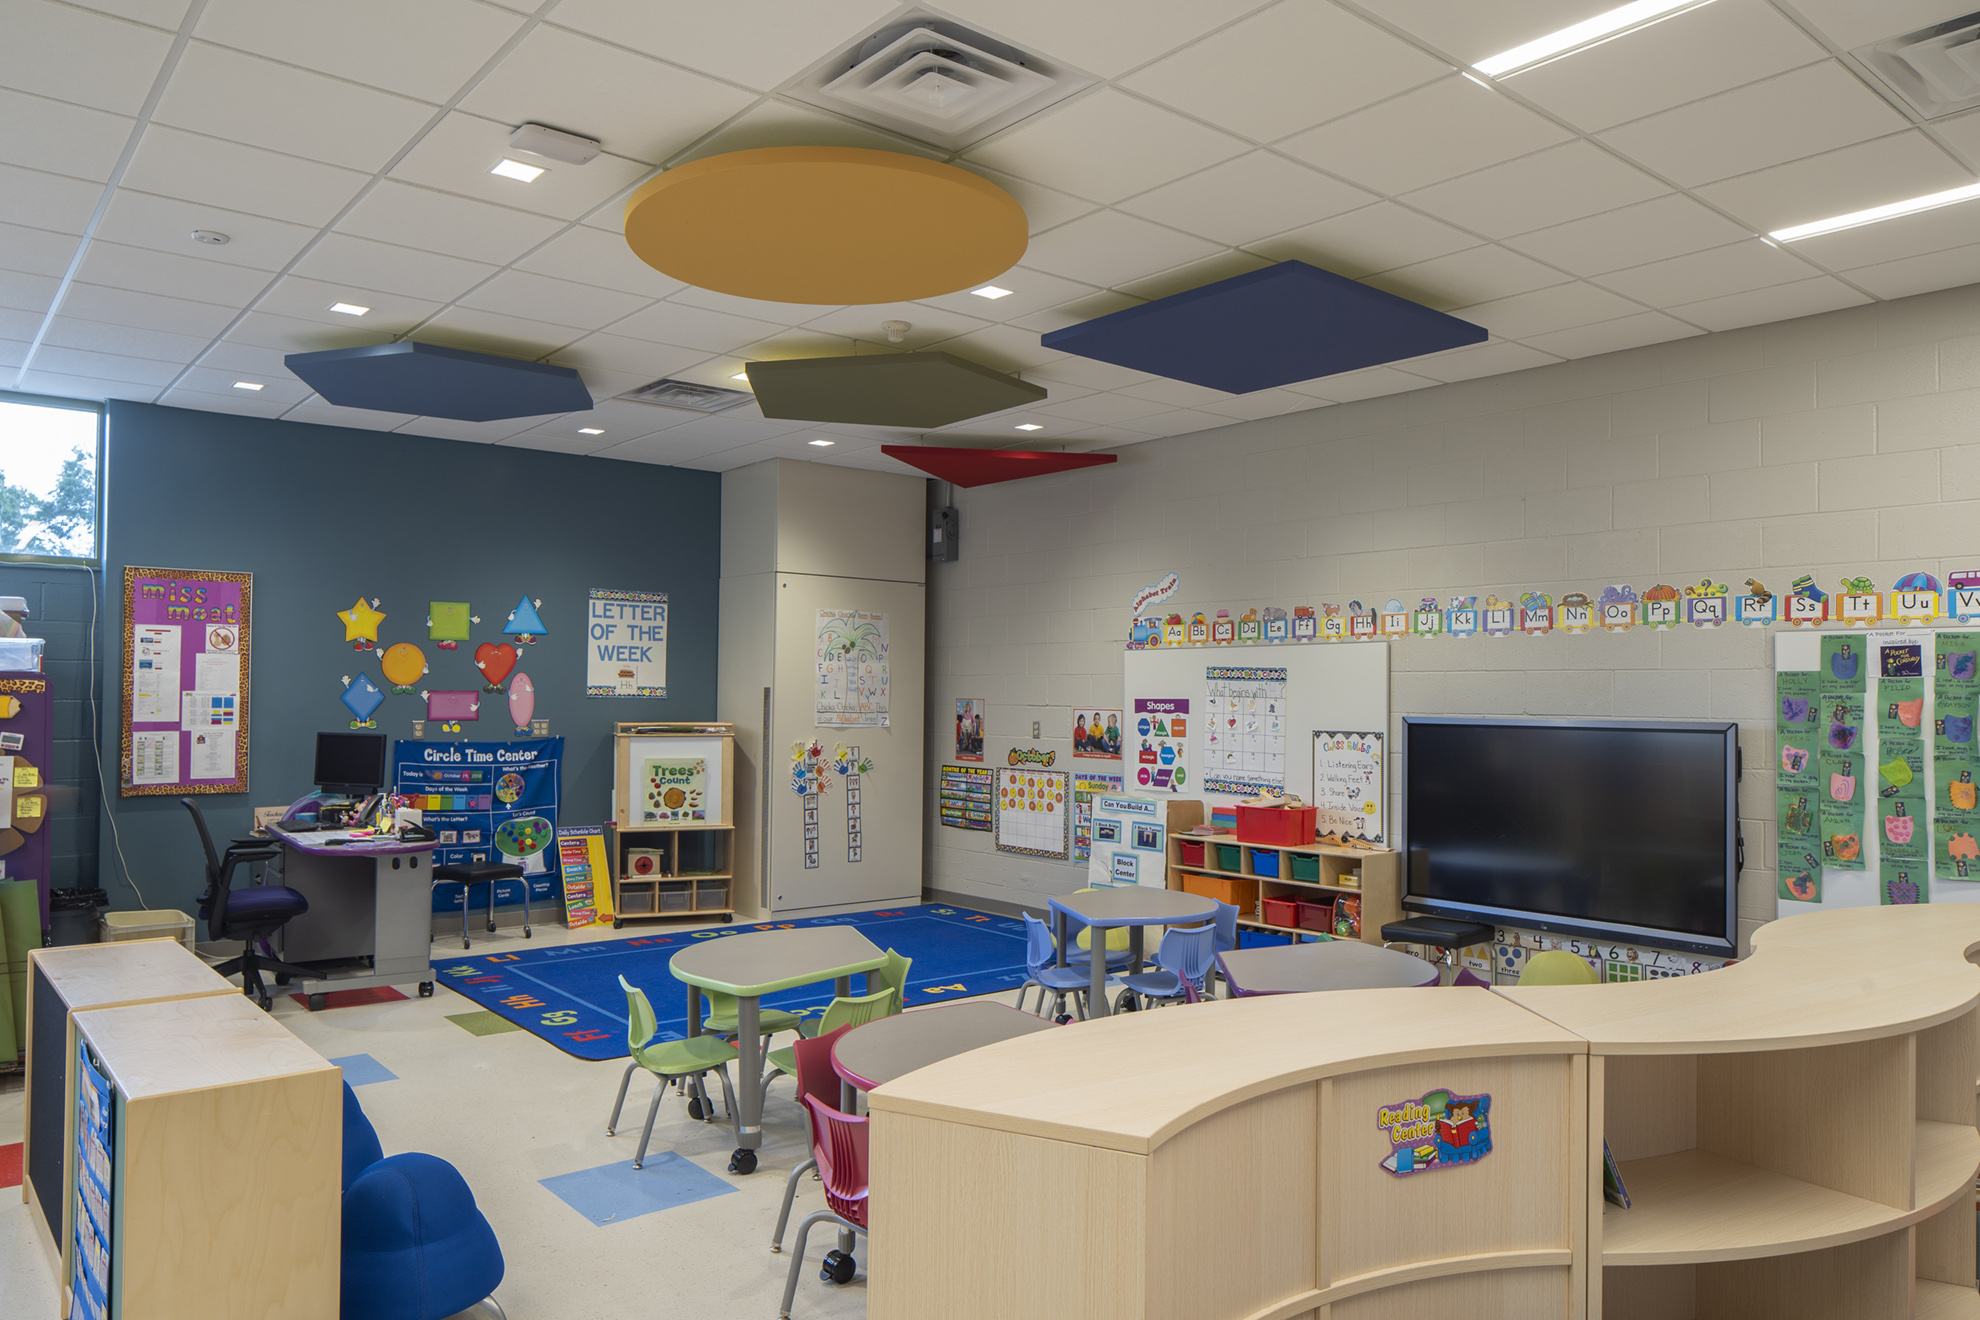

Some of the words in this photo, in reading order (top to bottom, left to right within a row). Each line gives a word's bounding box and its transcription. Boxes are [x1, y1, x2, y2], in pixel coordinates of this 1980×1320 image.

[142, 581, 207, 604] miss
[1134, 590, 1158, 612] Alphabet
[1160, 578, 1176, 594] Train
[1796, 598, 1816, 612] Ss
[1848, 596, 1870, 610] Tt
[1902, 594, 1928, 609] Uu
[167, 604, 236, 624] moat
[592, 602, 666, 622] LETTER
[1566, 608, 1586, 620] Nn
[1607, 605, 1628, 618] Oo
[1652, 602, 1670, 621] Pp
[1694, 600, 1718, 618] Qq
[1390, 615, 1400, 628] Ii
[1420, 614, 1434, 630] Jj
[1455, 613, 1472, 625] Kk
[1526, 610, 1548, 622] Mm
[1242, 622, 1256, 633] Dd
[1270, 622, 1282, 632] Ee
[1298, 619, 1310, 630] Ff
[1325, 619, 1340, 634] Gg
[1356, 617, 1372, 628] Hh
[590, 623, 618, 640] OF
[627, 624, 664, 642] THE
[1168, 626, 1182, 637] Aa
[1192, 626, 1204, 636] Bb
[1216, 624, 1230, 634] Cc
[597, 644, 653, 662] WEEK
[837, 652, 842, 662] E
[620, 680, 633, 689] Hh
[821, 674, 828, 684] I
[1206, 682, 1228, 697] What
[1146, 701, 1175, 712] Shapes
[881, 717, 889, 726] Z
[1323, 740, 1344, 752] CLASS
[1346, 741, 1372, 754] RULES
[424, 747, 461, 761] Circle
[465, 749, 493, 762] Time
[497, 749, 538, 761] Center
[1016, 750, 1050, 762] October
[652, 765, 694, 777] Trees
[1328, 760, 1357, 773] Listening
[1357, 760, 1374, 770] Ears
[660, 776, 691, 784] Count
[1326, 774, 1347, 786] Walking
[1348, 775, 1363, 783] Feet
[1088, 782, 1109, 791] Sunday
[1329, 788, 1345, 796] Share
[1127, 803, 1142, 811] Build
[1327, 801, 1346, 811] Inside
[1329, 816, 1338, 824] Be
[1339, 816, 1353, 826] Nice
[1117, 859, 1133, 867] Block
[1115, 869, 1134, 878] Center
[569, 902, 583, 910] Lunch
[1497, 930, 1505, 942] 3
[1533, 935, 1543, 949] 4
[1571, 940, 1580, 954] 5
[1609, 945, 1619, 959] 6
[1469, 960, 1483, 968] two
[1651, 951, 1660, 965] 7
[1501, 967, 1520, 975] three
[1691, 962, 1702, 974] 8
[1380, 1103, 1430, 1128] Reading
[1392, 1122, 1434, 1142] Center
